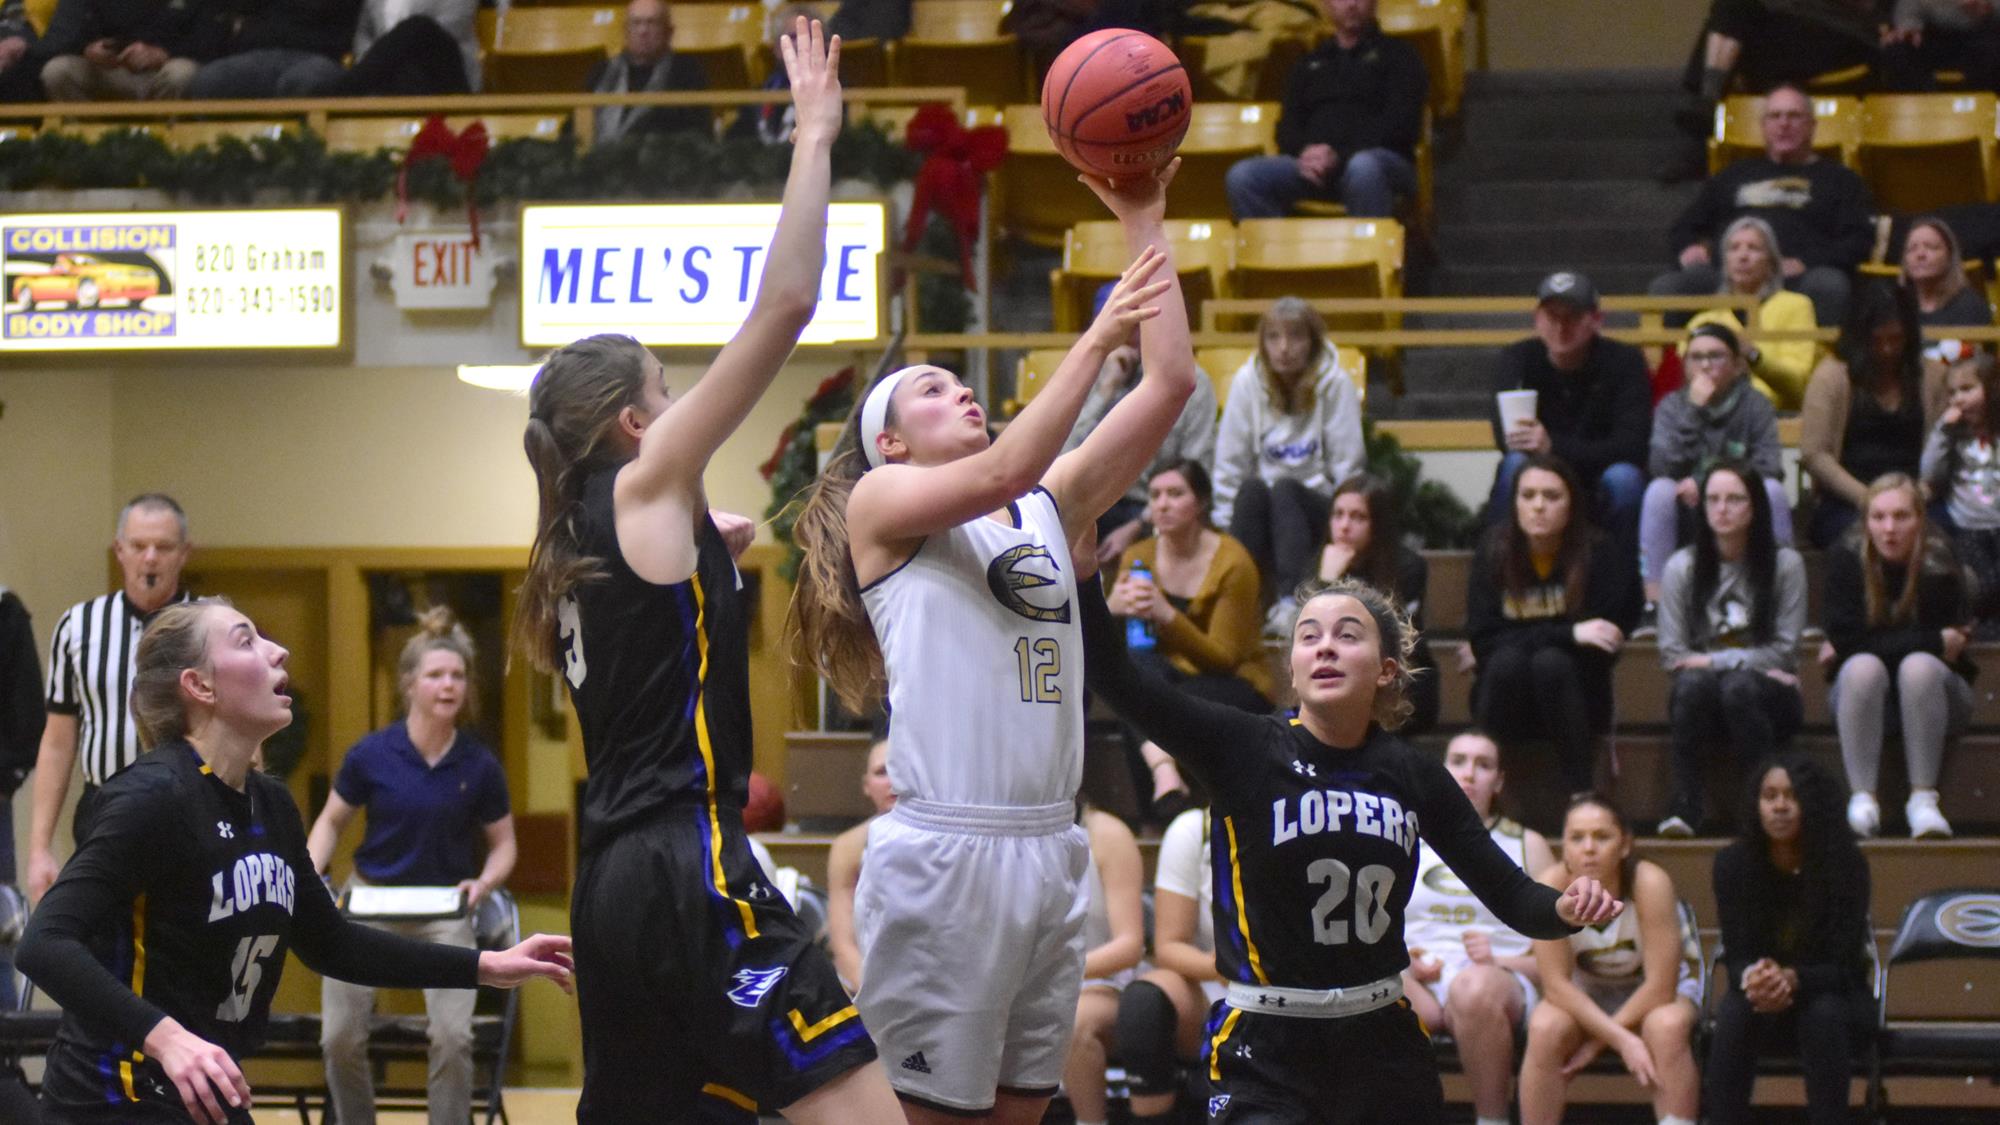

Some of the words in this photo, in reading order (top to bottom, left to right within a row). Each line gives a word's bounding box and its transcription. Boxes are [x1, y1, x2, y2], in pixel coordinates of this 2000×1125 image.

[11, 227, 170, 251] COLLISION
[196, 244, 234, 272] 820
[247, 244, 326, 272] Graham
[414, 241, 476, 287] EXIT
[538, 245, 712, 304] MEL'S
[733, 245, 866, 302] TE
[9, 314, 88, 338] BODY
[94, 312, 171, 337] SHOP
[1013, 636, 1063, 705] 12
[1272, 789, 1420, 857] LOPERS
[208, 853, 295, 924] LOPERS
[1306, 857, 1397, 946] 20
[215, 934, 280, 1023] 15
